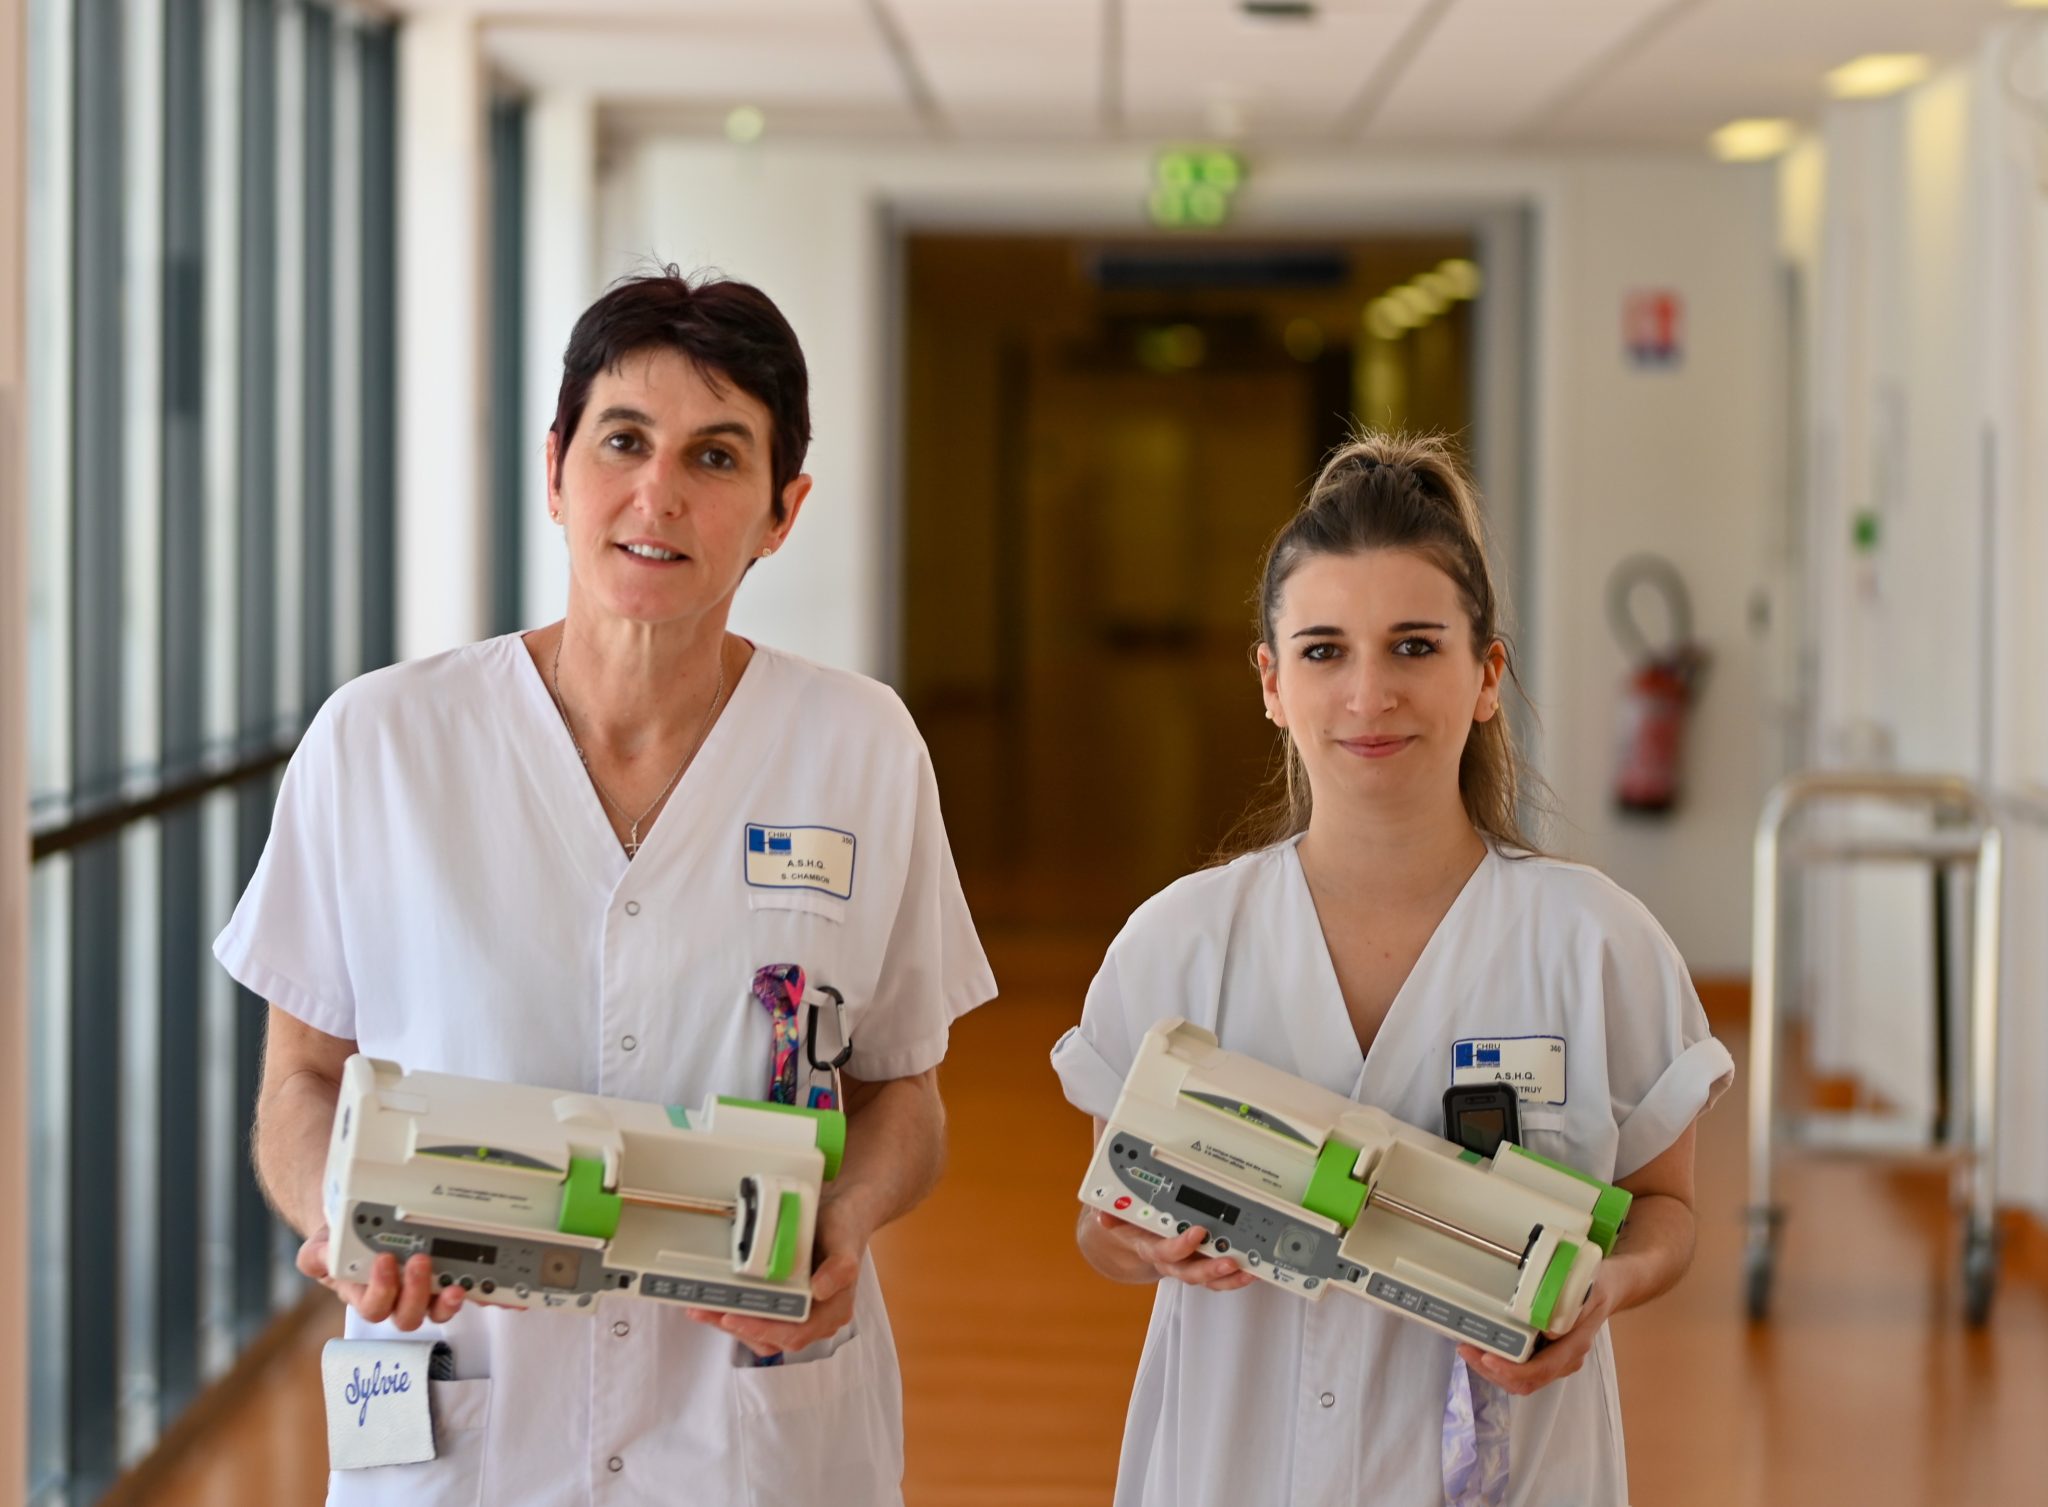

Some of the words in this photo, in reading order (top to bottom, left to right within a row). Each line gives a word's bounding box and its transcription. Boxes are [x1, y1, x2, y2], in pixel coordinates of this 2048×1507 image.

[787, 859, 825, 869] A.S.H.Q.
[1495, 1072, 1535, 1080] A.S.H.Q.
[345, 1360, 412, 1427] Sylvie
